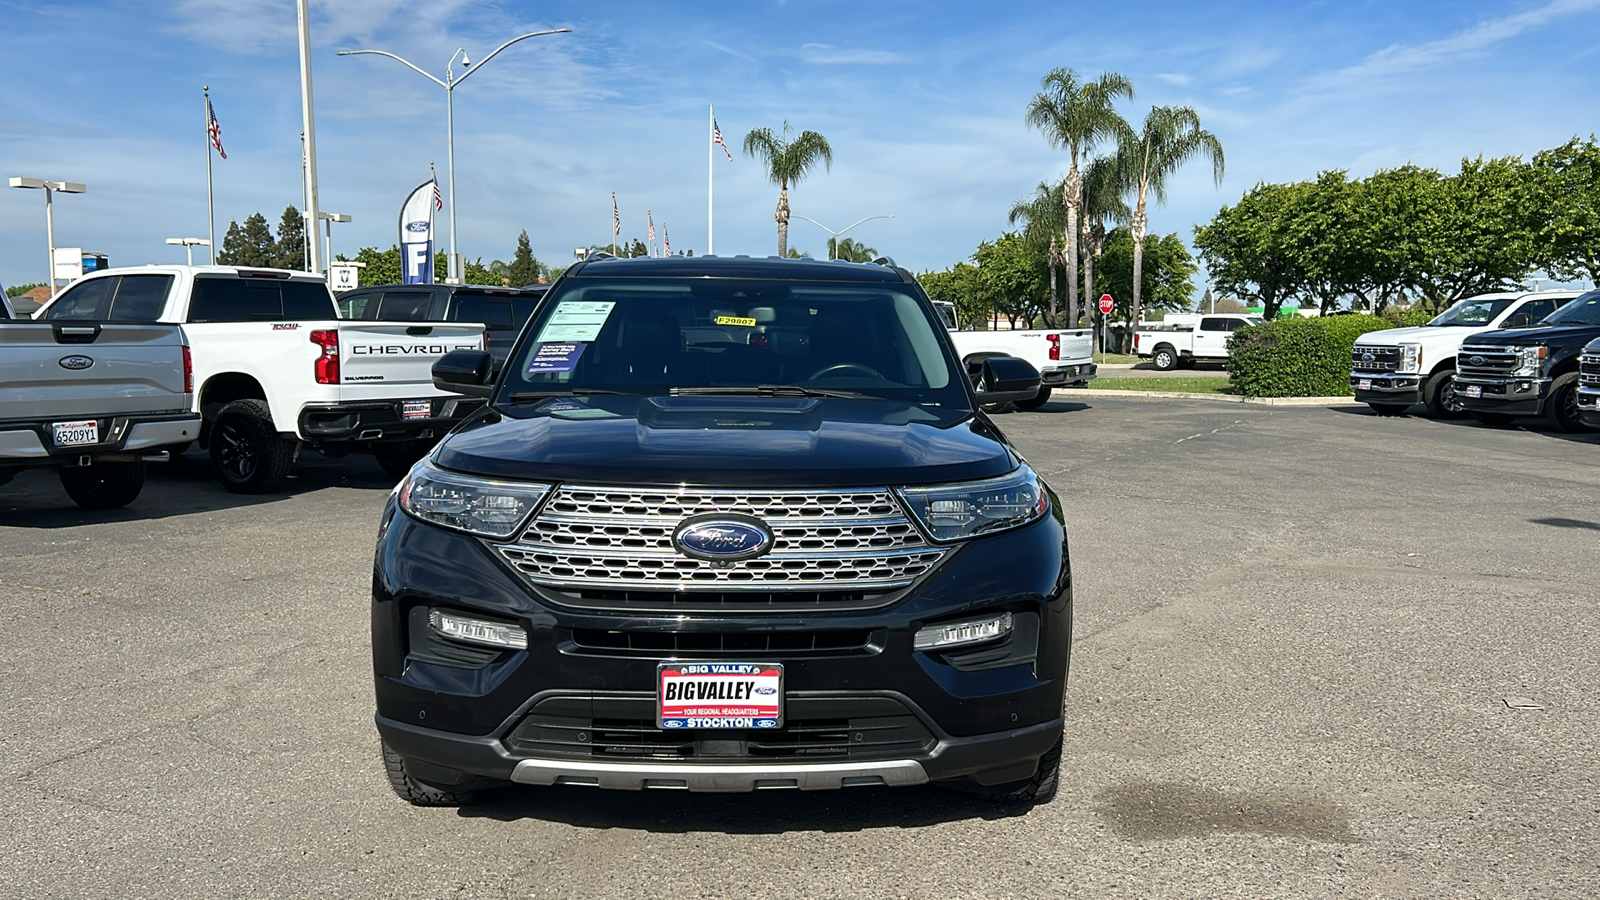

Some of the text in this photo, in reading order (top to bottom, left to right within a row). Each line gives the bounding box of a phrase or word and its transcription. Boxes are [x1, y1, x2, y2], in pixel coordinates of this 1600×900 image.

[1099, 300, 1113, 308] STOP
[718, 317, 754, 325] F29807
[56, 429, 96, 443] 65209Y1
[699, 527, 747, 549] Ford
[688, 665, 753, 674] BIG VALLEY
[665, 681, 755, 701] BIGVALLEY
[683, 708, 759, 716] YOUR REGIONAL HEADQUARTERS
[687, 717, 753, 728] STOCKTON
